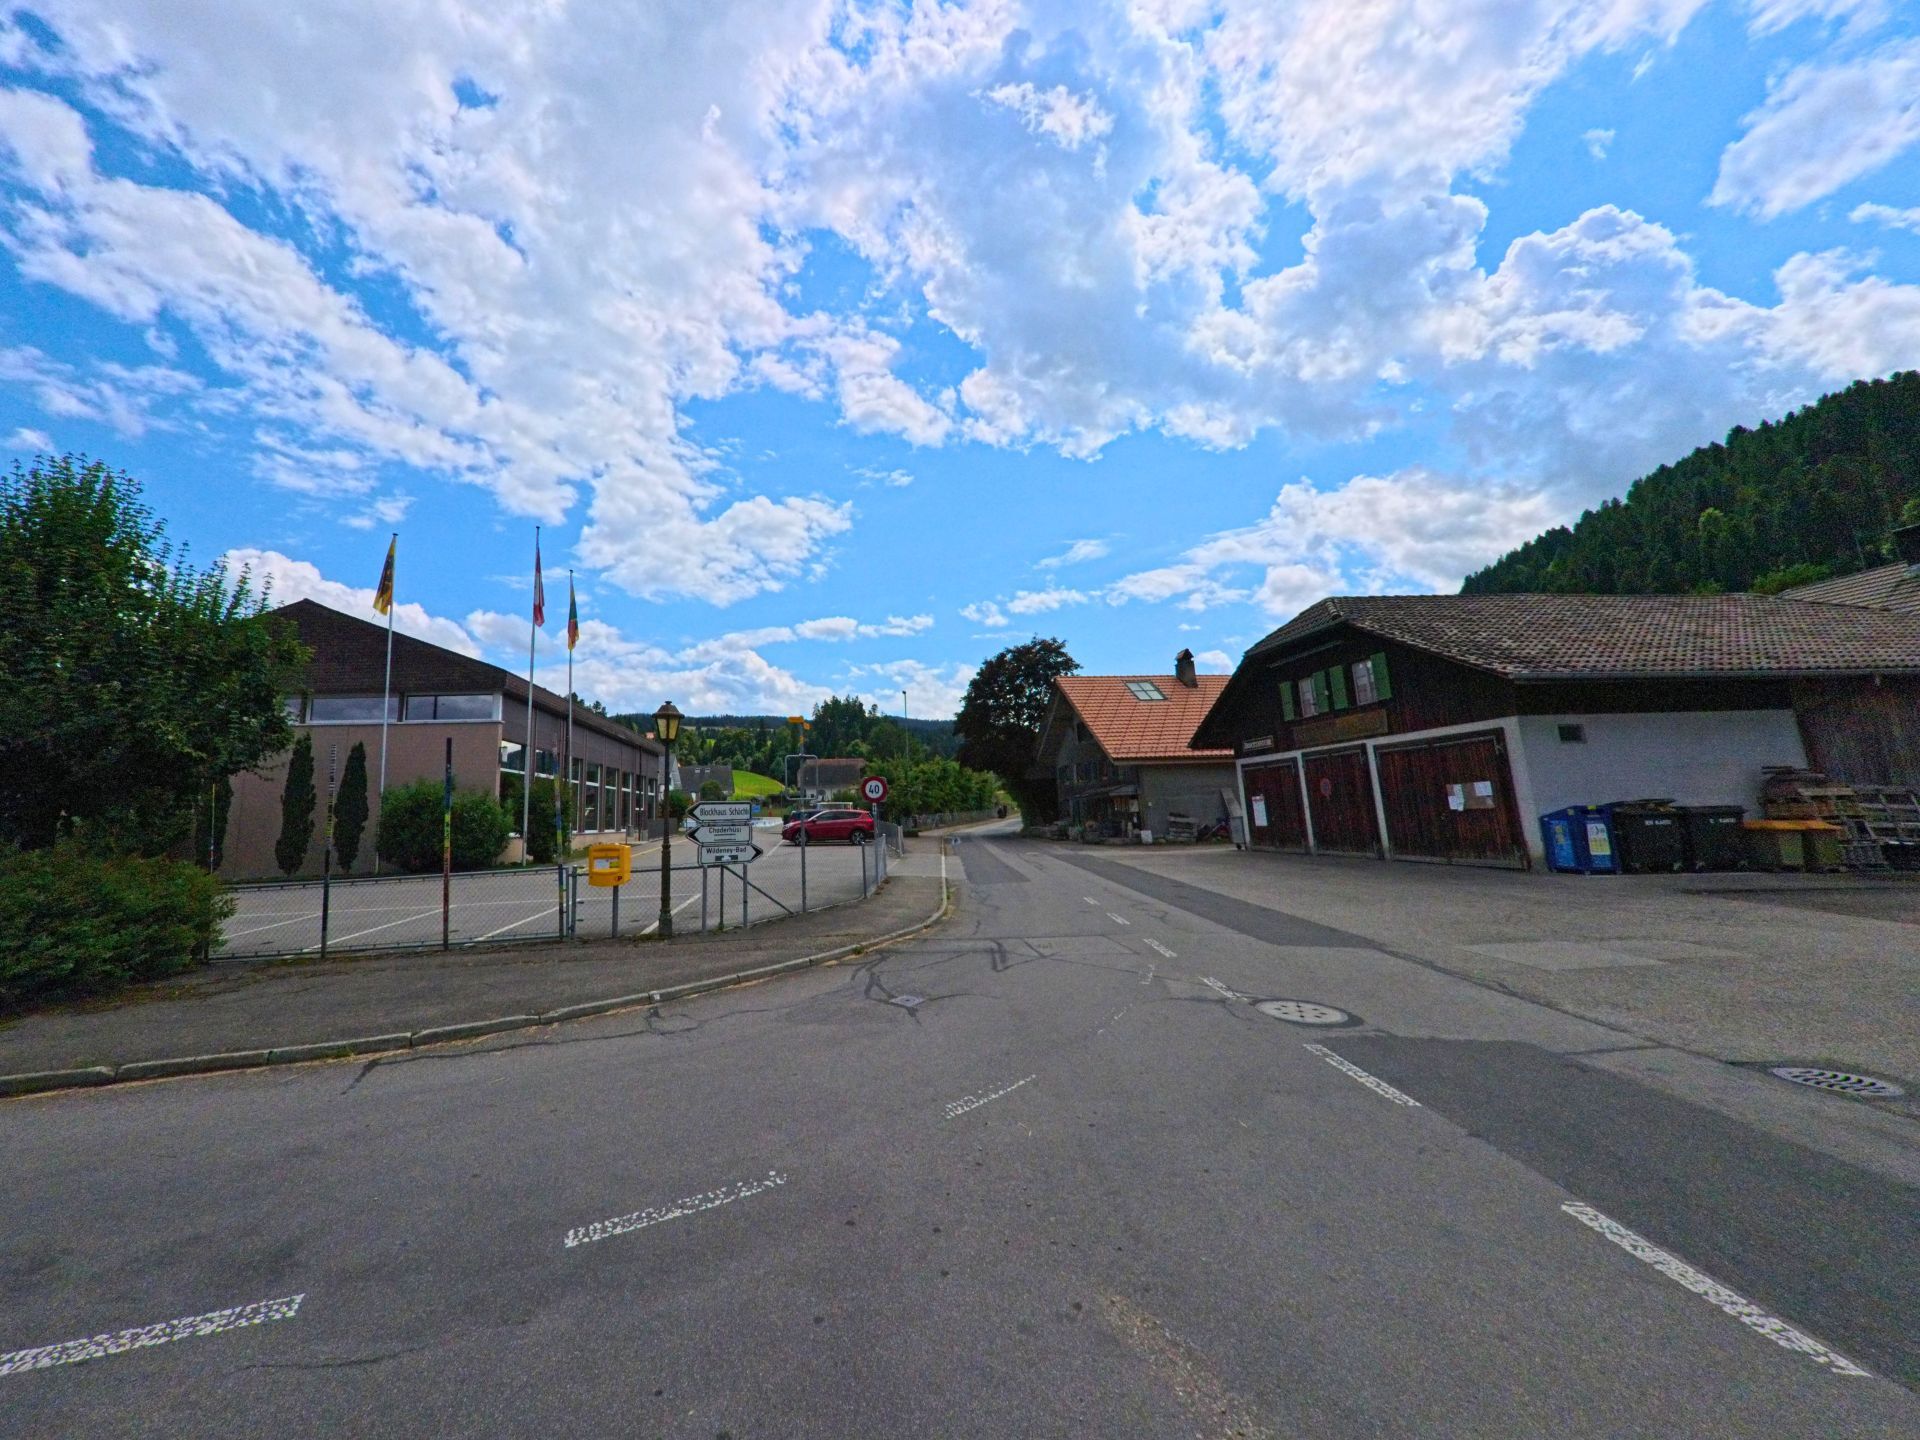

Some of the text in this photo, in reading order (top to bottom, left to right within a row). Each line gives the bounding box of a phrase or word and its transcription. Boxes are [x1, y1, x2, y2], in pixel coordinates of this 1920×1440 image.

[868, 784, 880, 794] 40
[699, 807, 727, 817] Blockhaus
[706, 846, 747, 855] Wildeney-Bad
